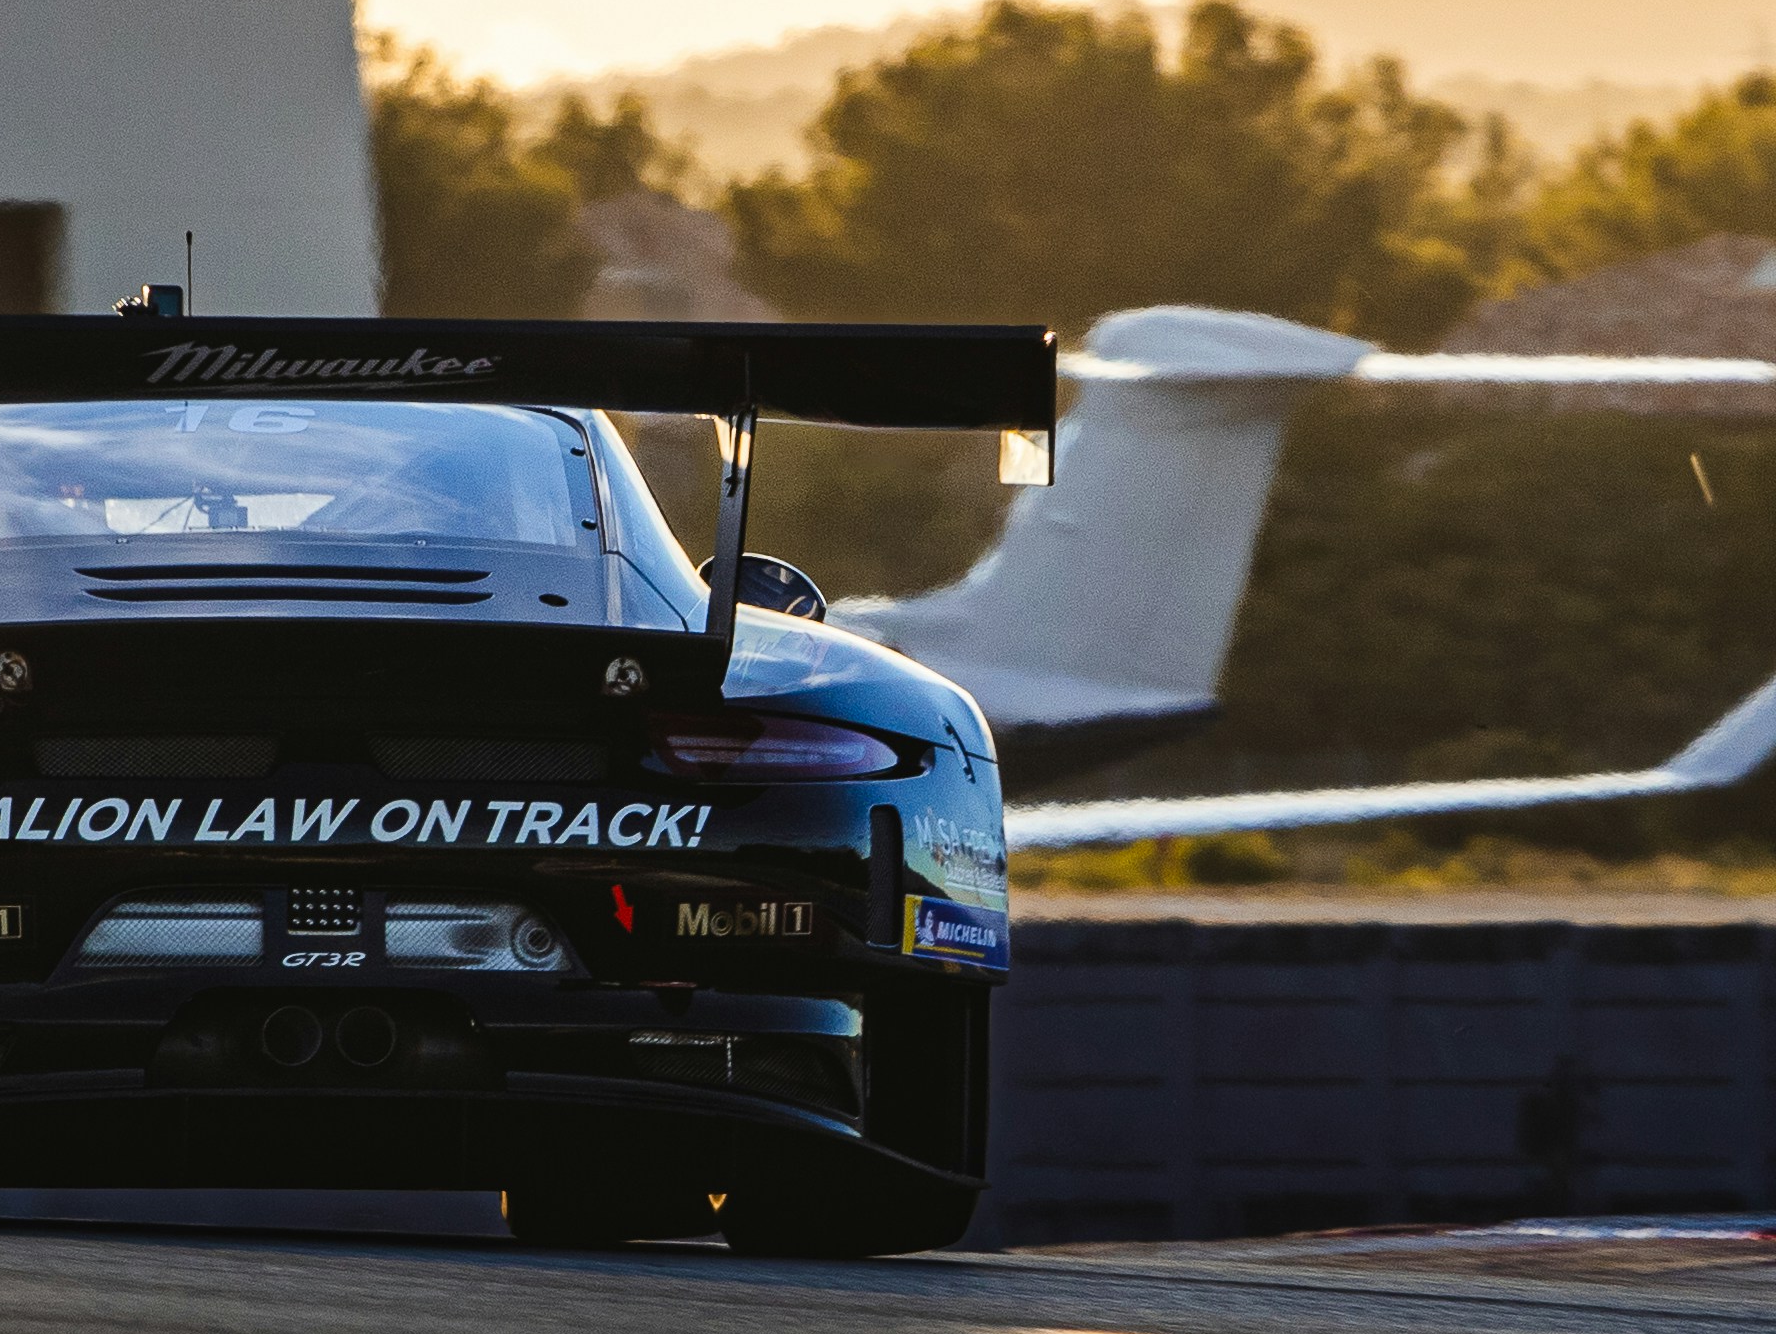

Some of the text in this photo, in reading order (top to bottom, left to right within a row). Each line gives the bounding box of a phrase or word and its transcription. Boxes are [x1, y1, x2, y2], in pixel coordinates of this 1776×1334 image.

[140, 340, 494, 384] Milwaukee
[194, 798, 361, 842] LAW
[370, 799, 472, 843] ON
[486, 800, 712, 848] TRACK!
[676, 902, 777, 936] Mobil
[936, 921, 998, 948] MICHELIN
[282, 951, 367, 967] GT3R
